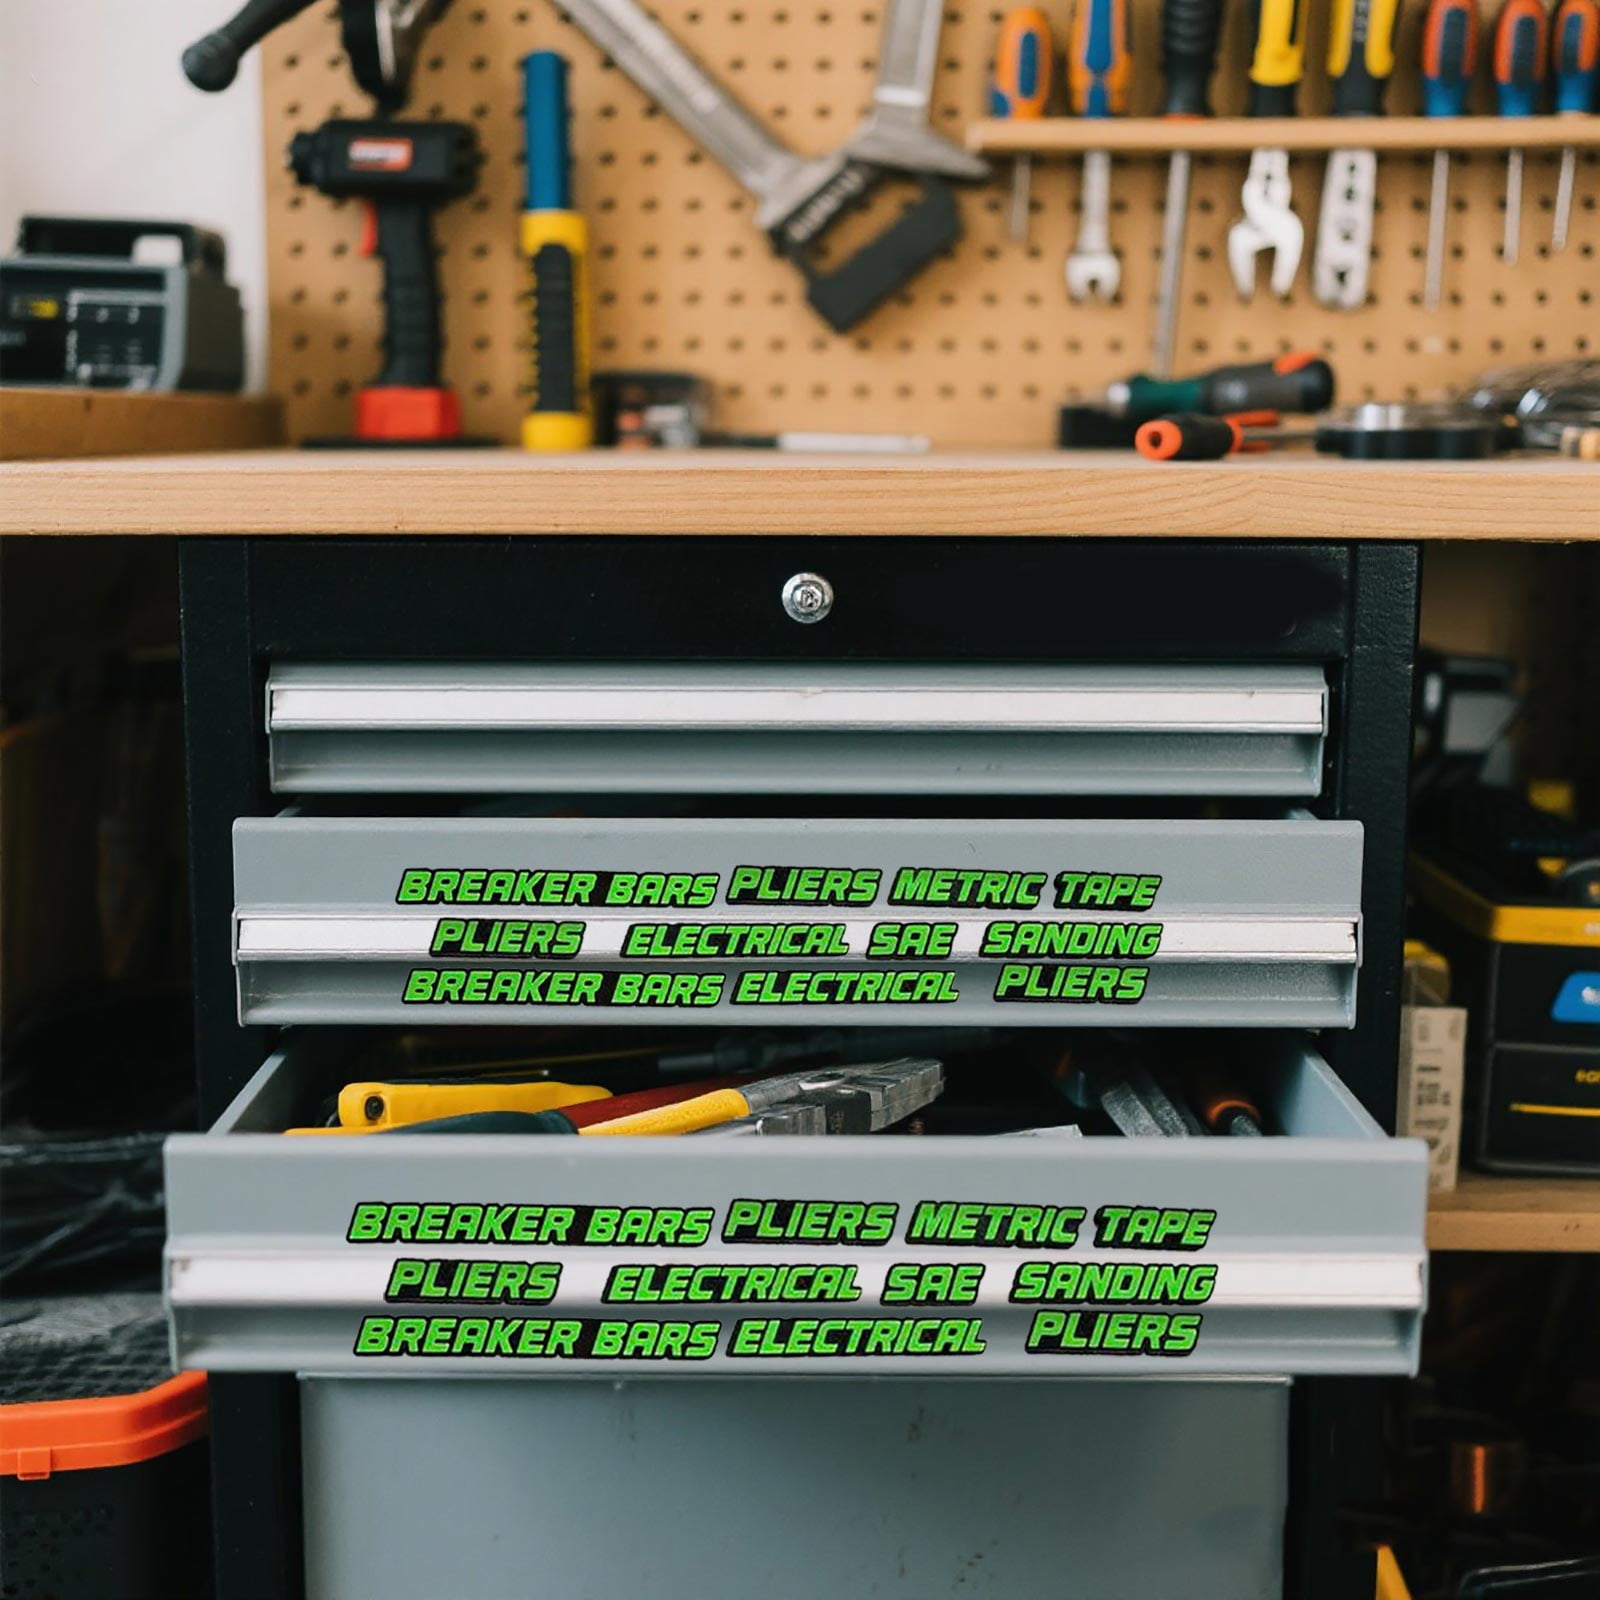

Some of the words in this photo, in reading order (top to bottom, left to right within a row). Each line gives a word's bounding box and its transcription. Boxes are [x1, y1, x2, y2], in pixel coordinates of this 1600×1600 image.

[397, 869, 599, 905] BREAKER
[606, 872, 720, 907] BARS
[727, 866, 879, 903] PLIERS
[891, 868, 1047, 906] METRIC
[1060, 872, 1162, 908] TAPE
[431, 918, 583, 955] PLIERS
[625, 923, 849, 957] ELECTRICAL
[868, 923, 955, 957] SAE
[982, 921, 1161, 956] SANDING
[403, 969, 605, 1004] BREAKER
[612, 972, 726, 1006] BARS
[735, 970, 959, 1004] ELECTRICAL
[995, 963, 1149, 1000] PLIERS
[348, 1203, 577, 1243] BREAKER
[586, 1207, 712, 1245] BARS
[724, 1200, 897, 1241] PLIERS
[910, 1202, 1084, 1245] METRIC
[1102, 1206, 1217, 1247] TAPE
[387, 1259, 558, 1301] PLIERS
[607, 1265, 862, 1303] ELECTRICAL
[882, 1264, 982, 1302] SAE
[1012, 1262, 1217, 1302] SANDING
[355, 1316, 584, 1356] BREAKER
[592, 1320, 721, 1358] BARS
[732, 1318, 987, 1356] ELECTRICAL
[1027, 1310, 1201, 1352] PLIERS
